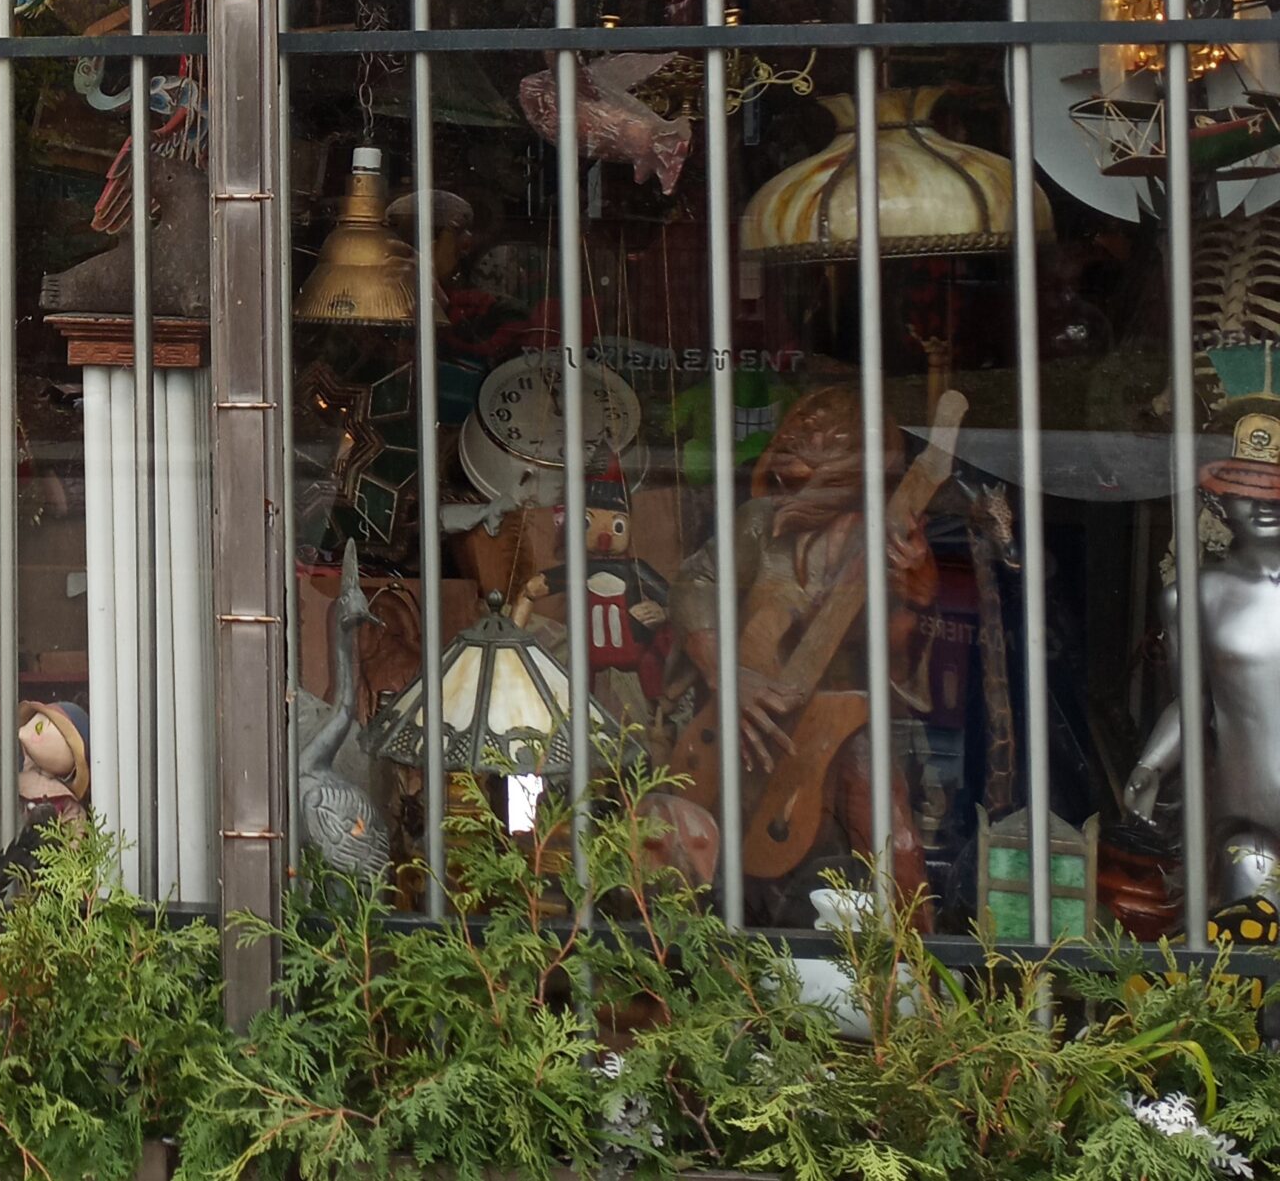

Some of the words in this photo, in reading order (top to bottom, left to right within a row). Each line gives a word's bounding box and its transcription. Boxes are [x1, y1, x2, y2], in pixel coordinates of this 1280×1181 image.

[500, 390, 521, 404] 10
[495, 408, 512, 422] 9
[507, 426, 522, 440] 8
